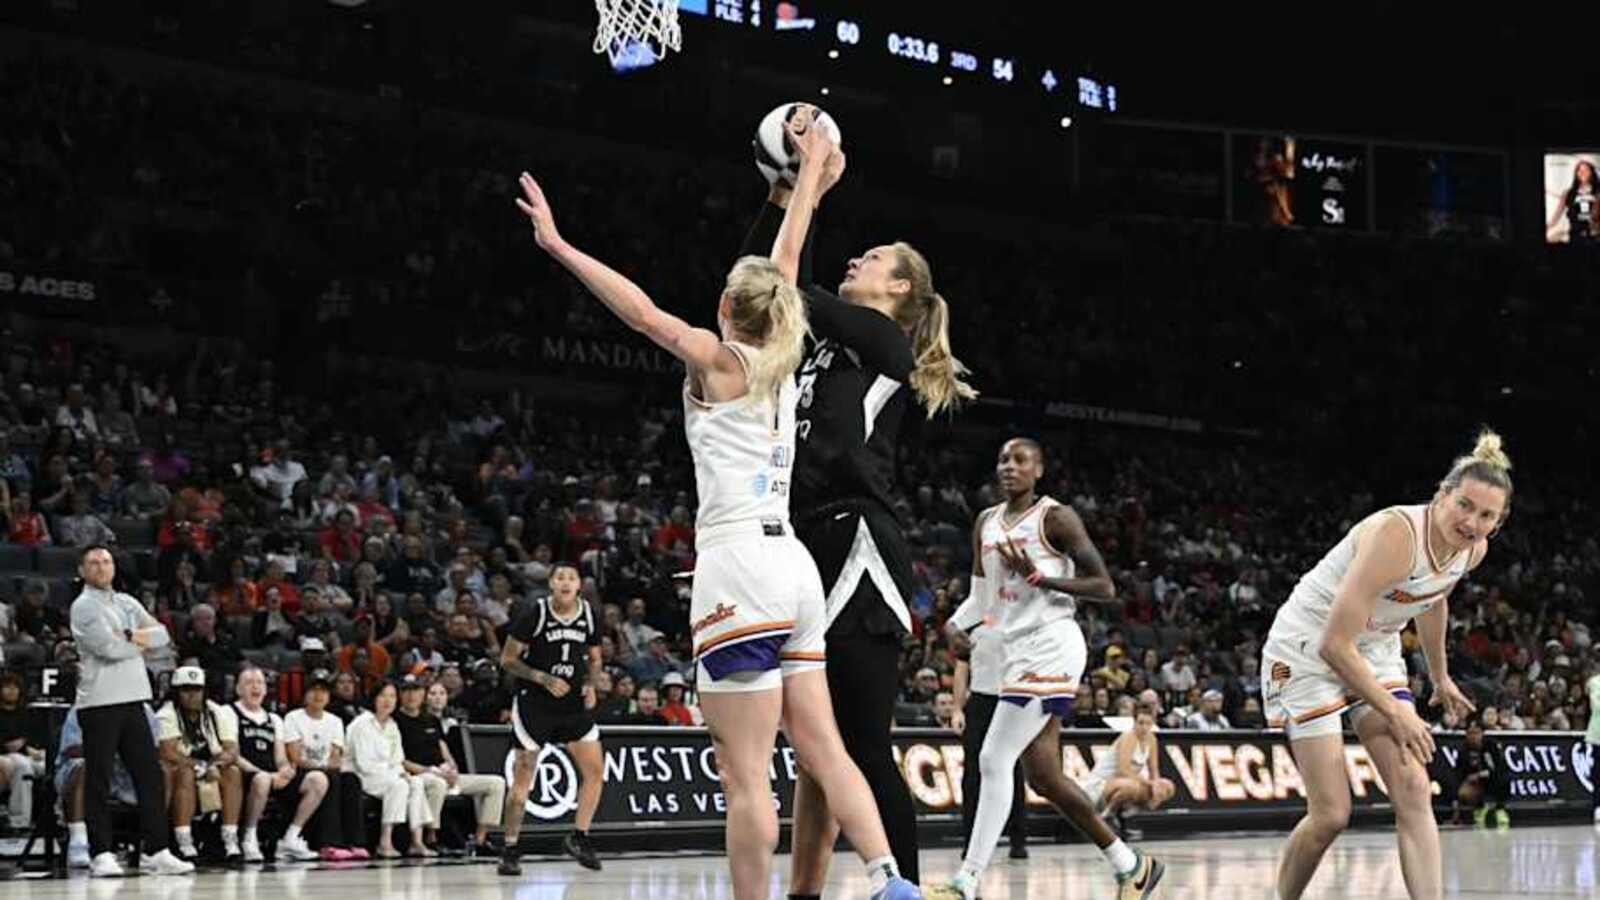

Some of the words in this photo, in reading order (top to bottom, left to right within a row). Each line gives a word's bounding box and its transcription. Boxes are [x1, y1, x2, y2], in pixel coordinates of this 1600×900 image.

[836, 20, 859, 45] 60
[887, 32, 940, 64] 0:33.6
[992, 57, 1014, 82] 54
[542, 334, 667, 371] MANDAL
[561, 642, 570, 662] 1
[42, 668, 59, 695] F
[551, 663, 575, 678] ring
[602, 746, 799, 782] WESTGE
[1165, 744, 1308, 801] VEGA
[628, 793, 680, 814] LAS
[692, 792, 781, 814] VES
